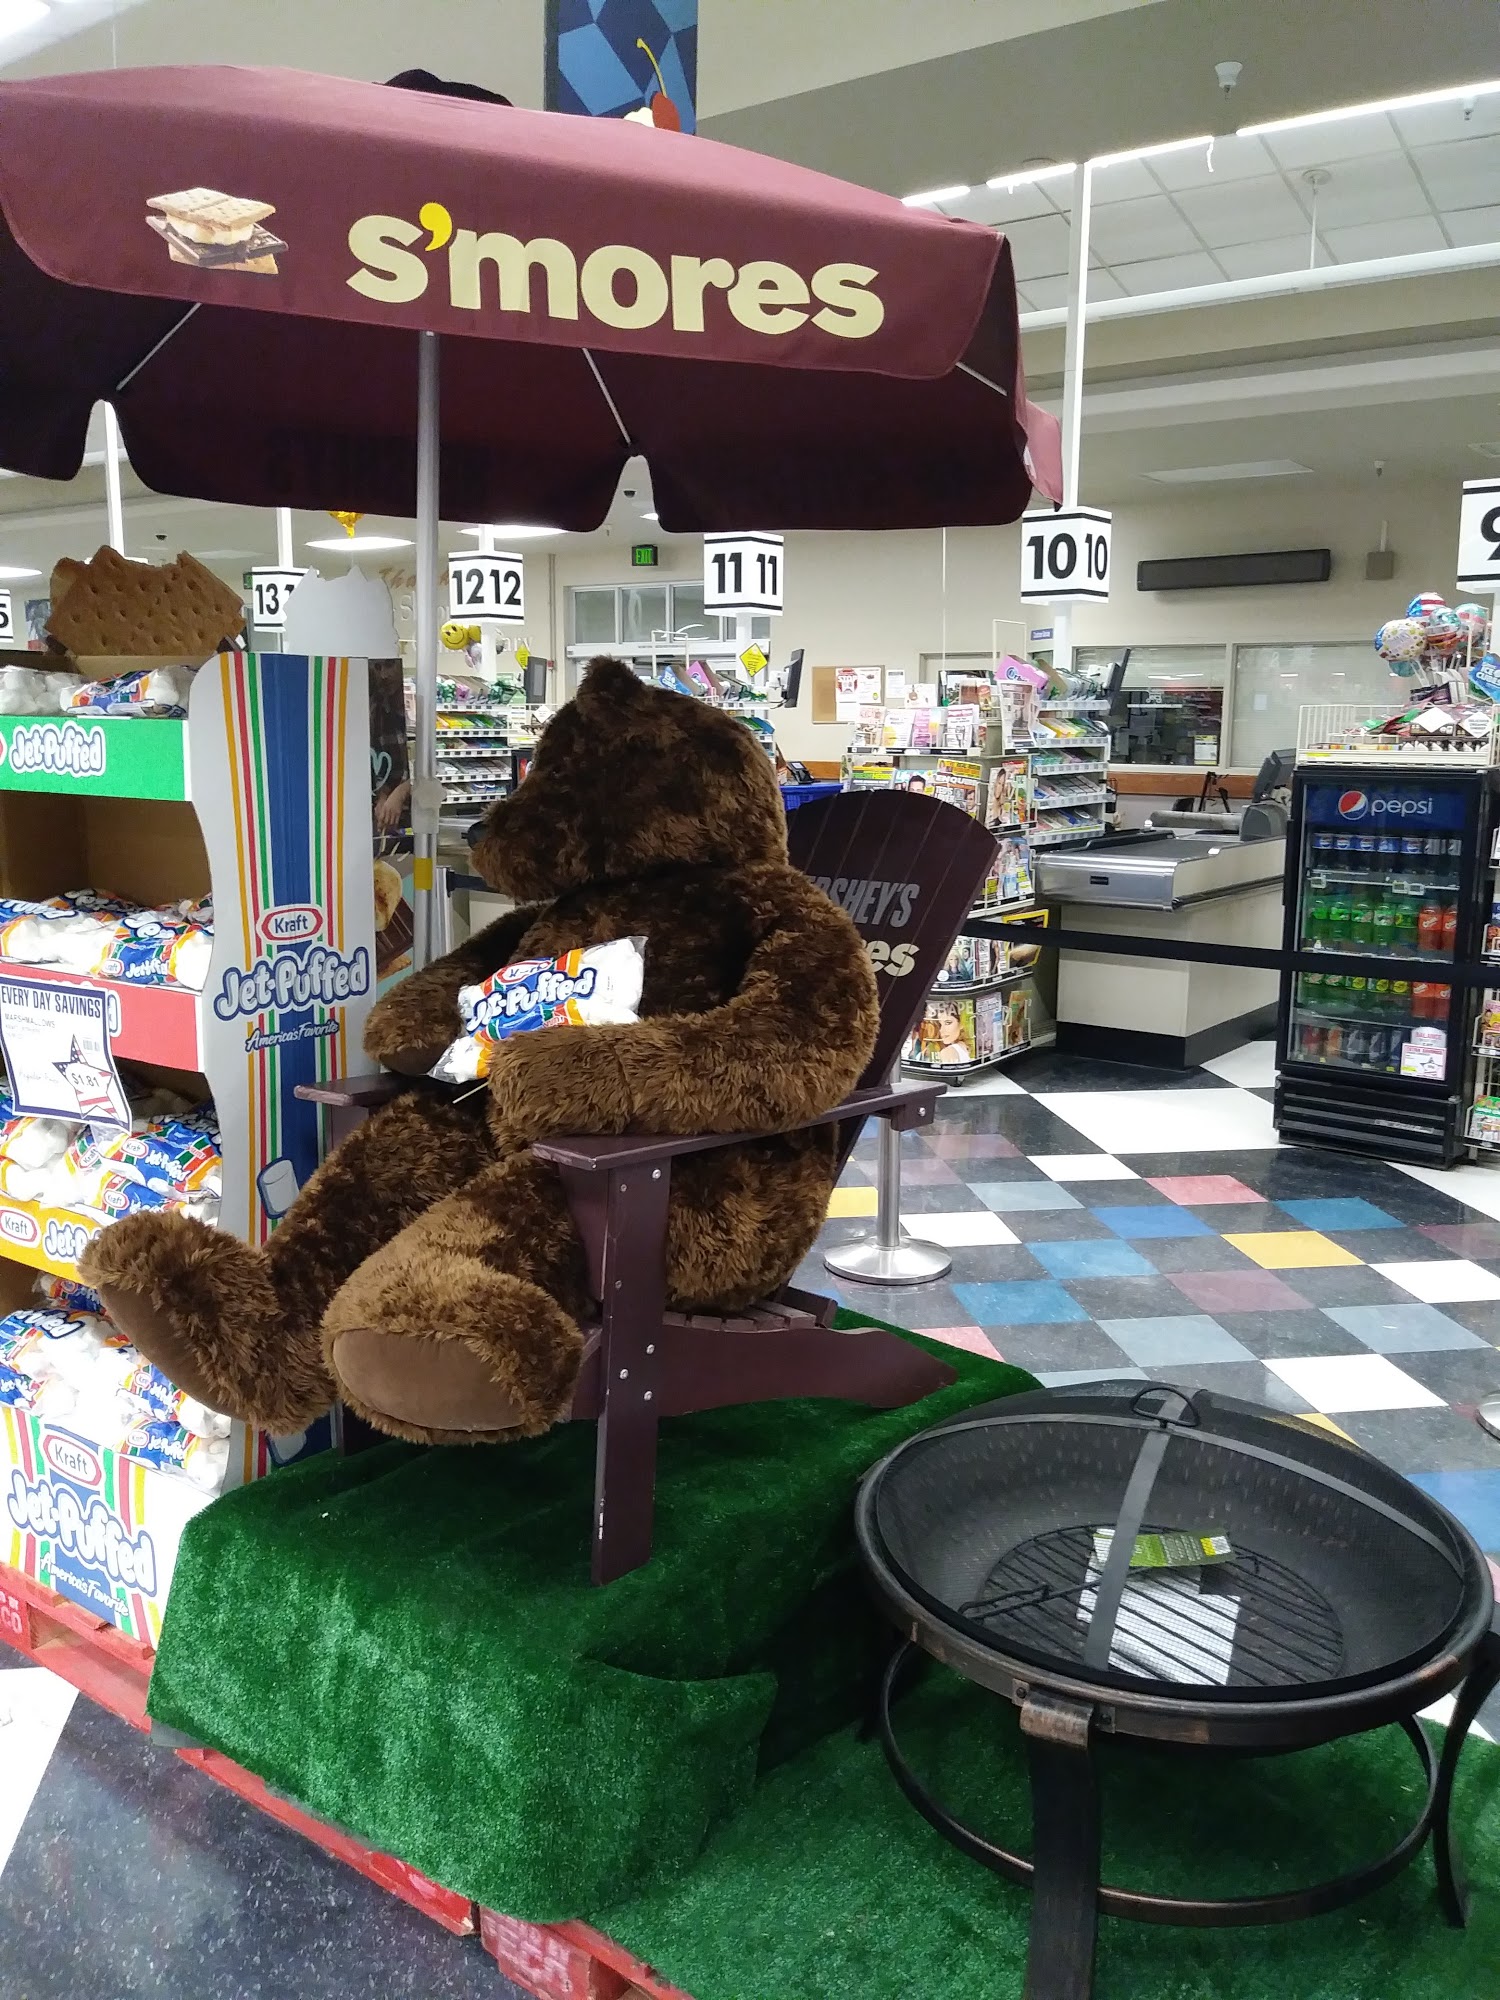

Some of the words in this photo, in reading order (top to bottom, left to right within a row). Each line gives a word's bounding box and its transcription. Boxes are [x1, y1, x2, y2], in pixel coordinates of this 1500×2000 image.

[346, 202, 884, 339] s'mores
[711, 552, 742, 594] 11
[756, 553, 777, 595] 11
[1027, 533, 1077, 580] 10
[1085, 533, 1108, 580] 10
[255, 583, 280, 615] 13
[452, 568, 485, 605] 12
[490, 569, 522, 606] 12
[1371, 798, 1433, 817] pepsi
[804, 875, 920, 928] SHEY'S
[274, 914, 309, 933] Kraft
[1, 986, 29, 1007] EVERY
[33, 990, 51, 1011] DAY
[55, 993, 101, 1019] SAVINGS
[245, 1027, 300, 1052] America's
[298, 1018, 340, 1041] Favorite
[5, 1216, 28, 1235] Kraft
[45, 1221, 101, 1261] Jet-P
[54, 1445, 89, 1475] Kraft
[86, 1580, 129, 1617] Favorite
